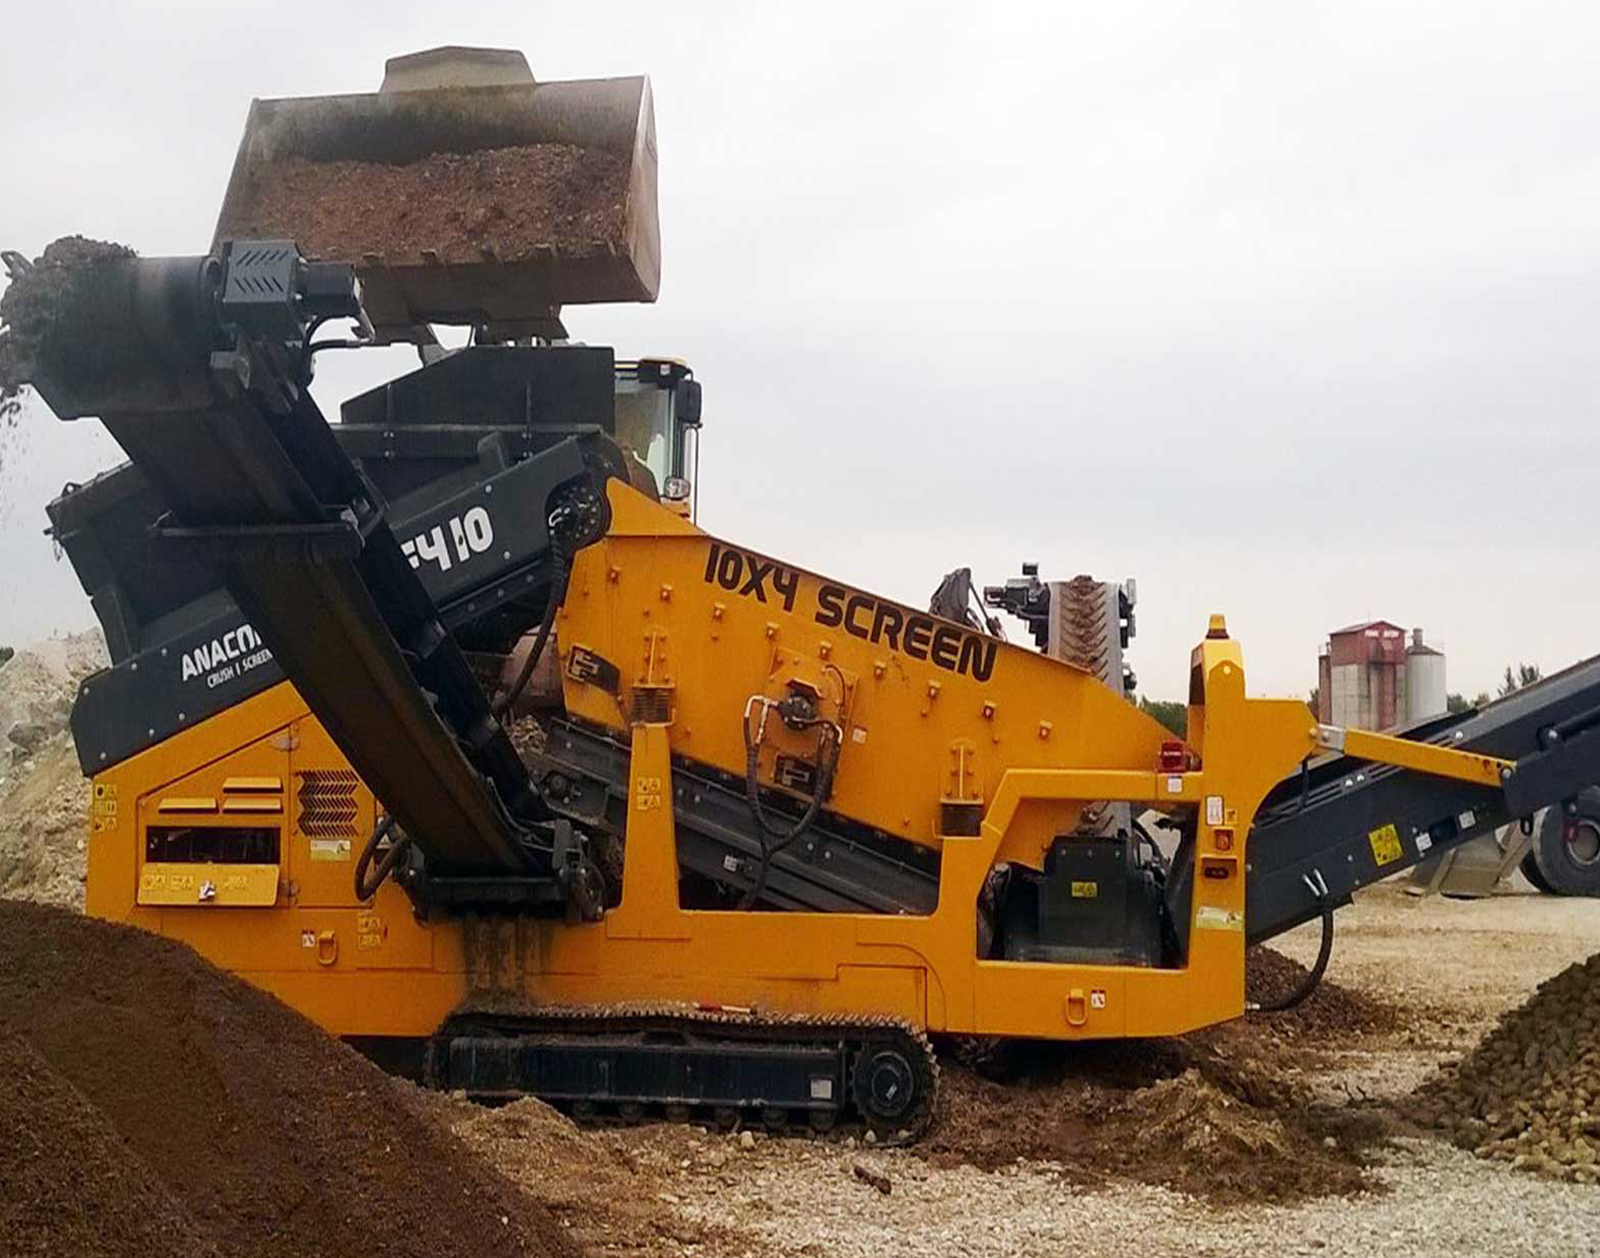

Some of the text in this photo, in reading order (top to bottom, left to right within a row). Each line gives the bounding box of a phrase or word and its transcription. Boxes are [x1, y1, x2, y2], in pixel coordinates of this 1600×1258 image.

[182, 623, 262, 682] ANACO
[704, 544, 998, 683] 10X4 SCREEN
